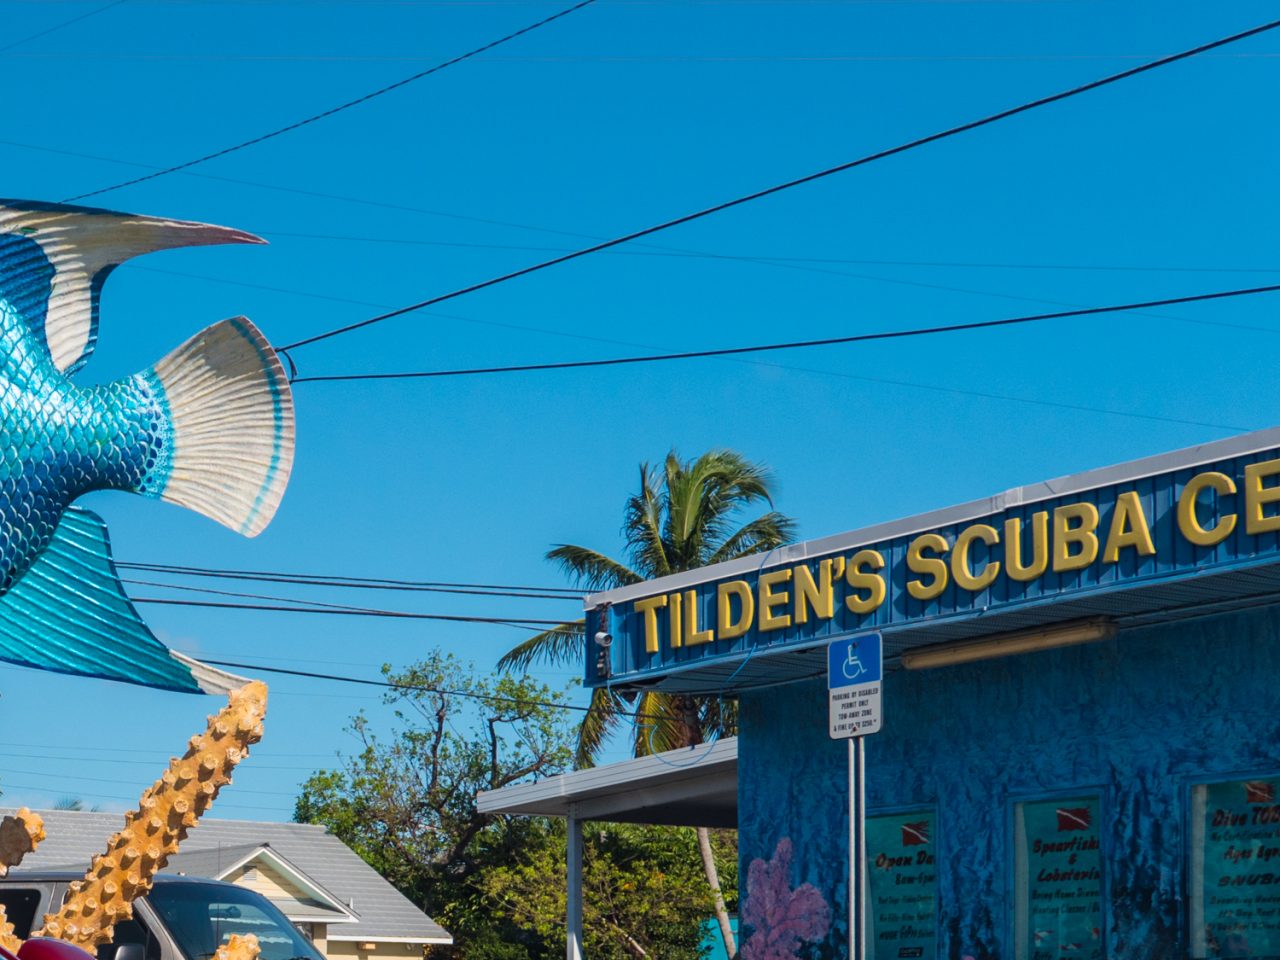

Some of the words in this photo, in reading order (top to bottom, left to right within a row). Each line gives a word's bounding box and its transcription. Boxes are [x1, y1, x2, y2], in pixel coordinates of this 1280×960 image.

[633, 550, 886, 654] TILDEN'S
[906, 490, 1156, 600] SCUBA
[832, 692, 850, 701] PARKING
[858, 688, 878, 696] DISABLED
[841, 701, 857, 710] PERMIT
[858, 699, 868, 707] ONLY
[1212, 809, 1248, 826] Dive
[876, 852, 912, 871] Open
